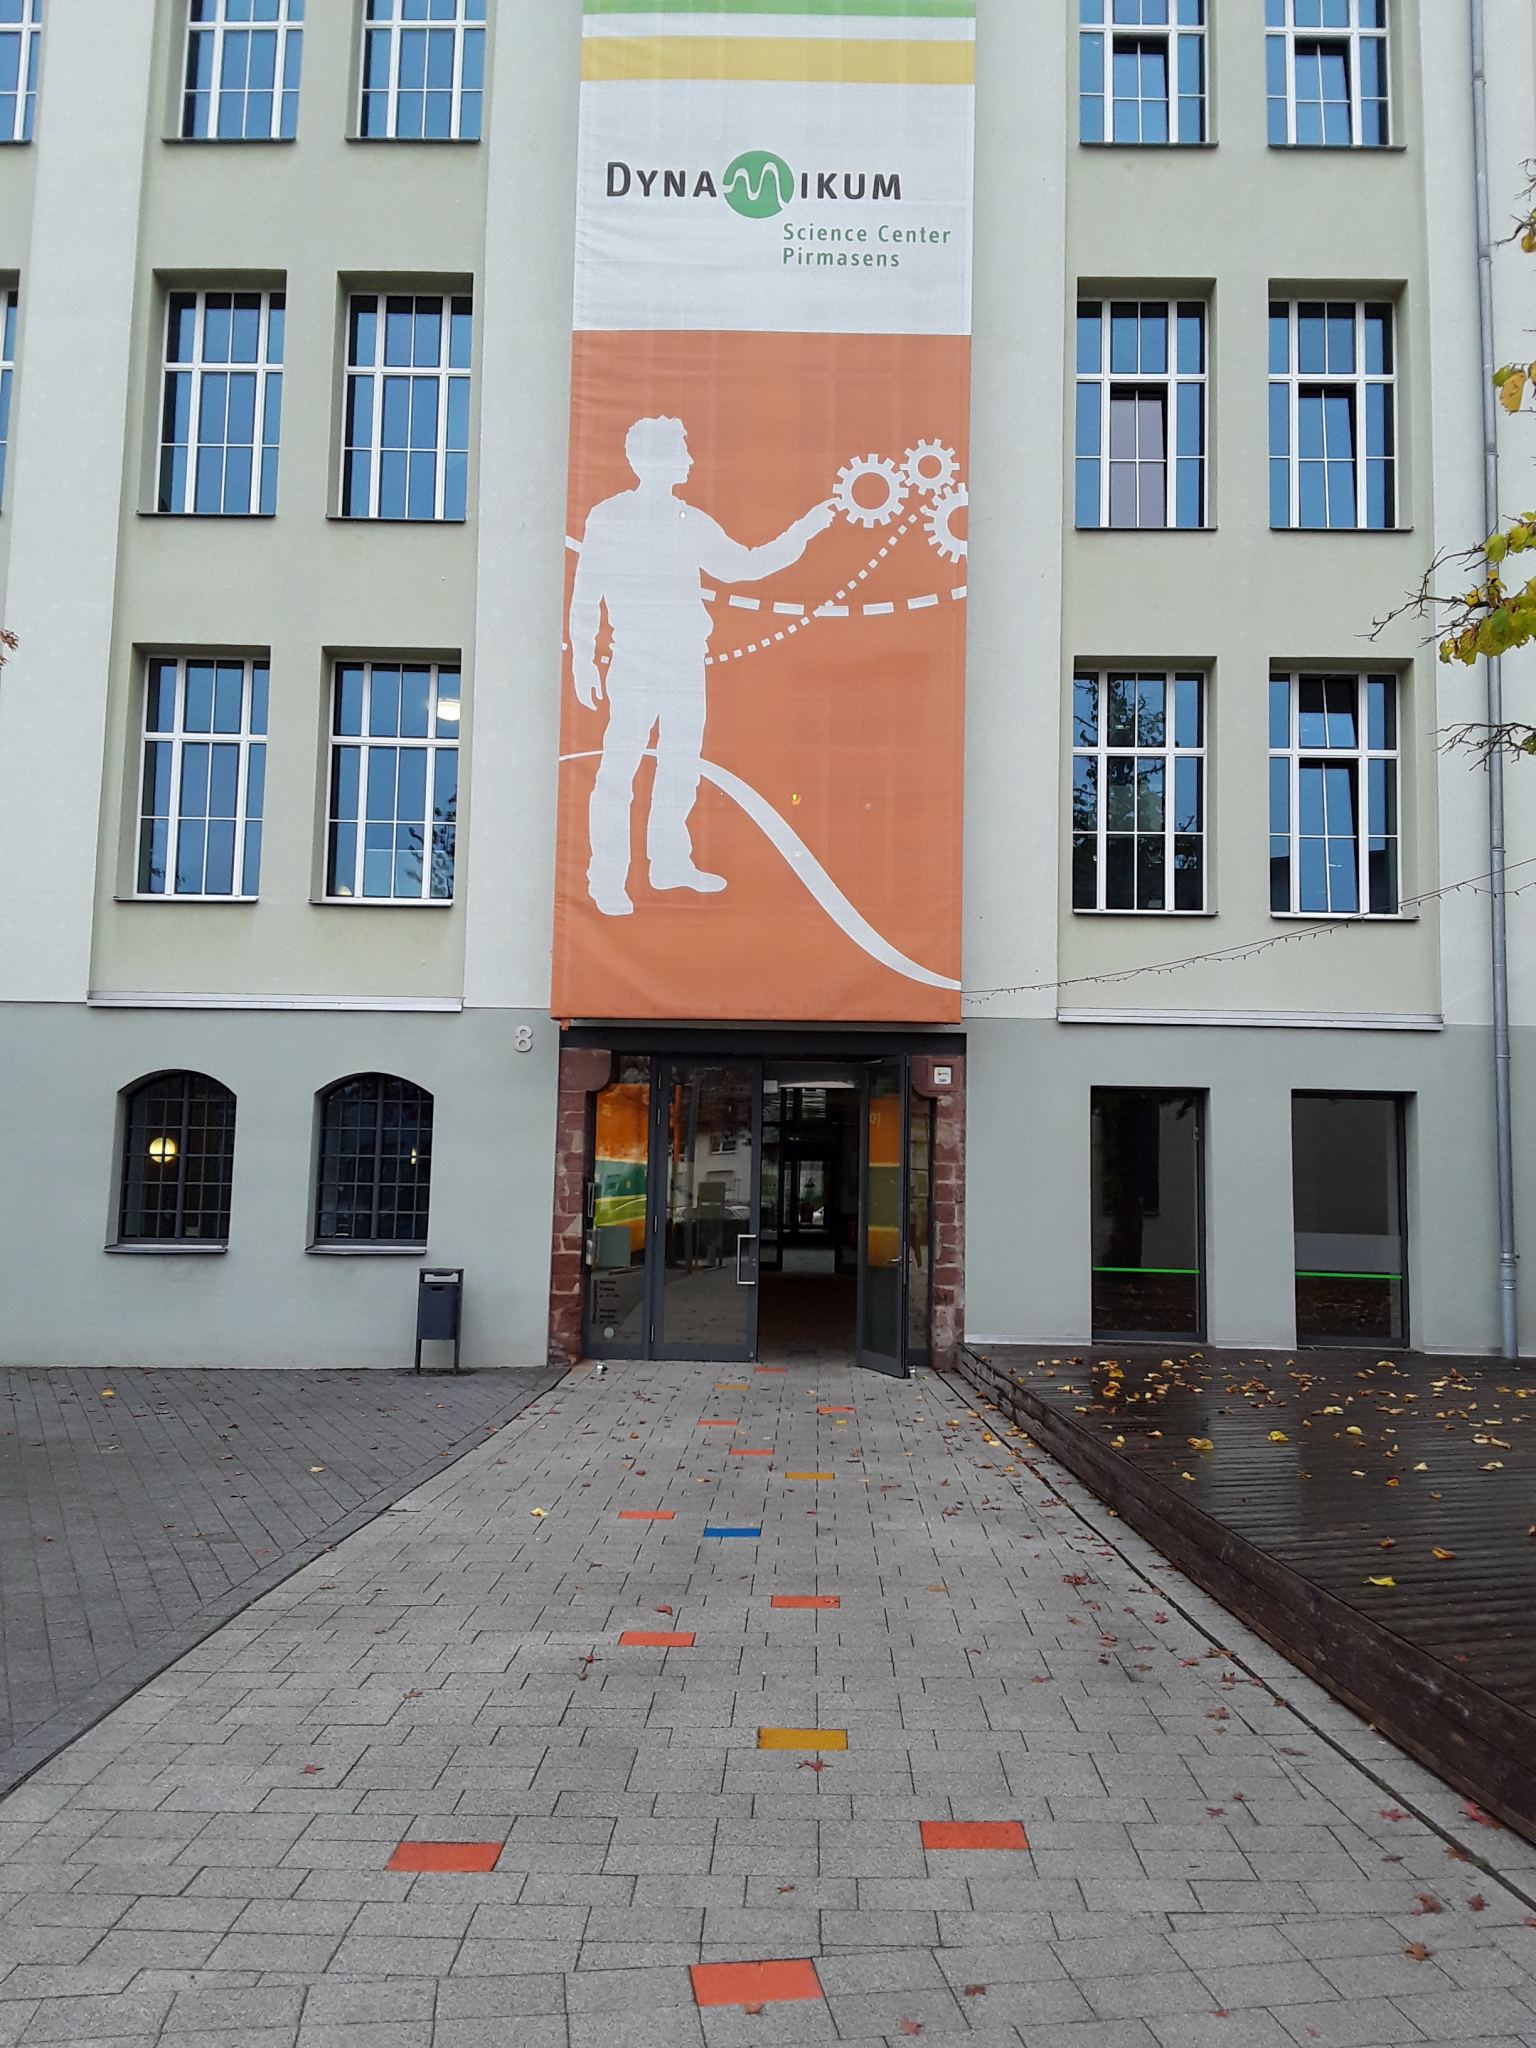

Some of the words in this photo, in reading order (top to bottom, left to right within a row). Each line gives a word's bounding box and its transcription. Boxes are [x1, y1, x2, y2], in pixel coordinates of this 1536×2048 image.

[783, 223, 867, 243] Science
[877, 225, 951, 244] Center
[783, 247, 900, 268] Pirmasens
[514, 1025, 533, 1052] 8
